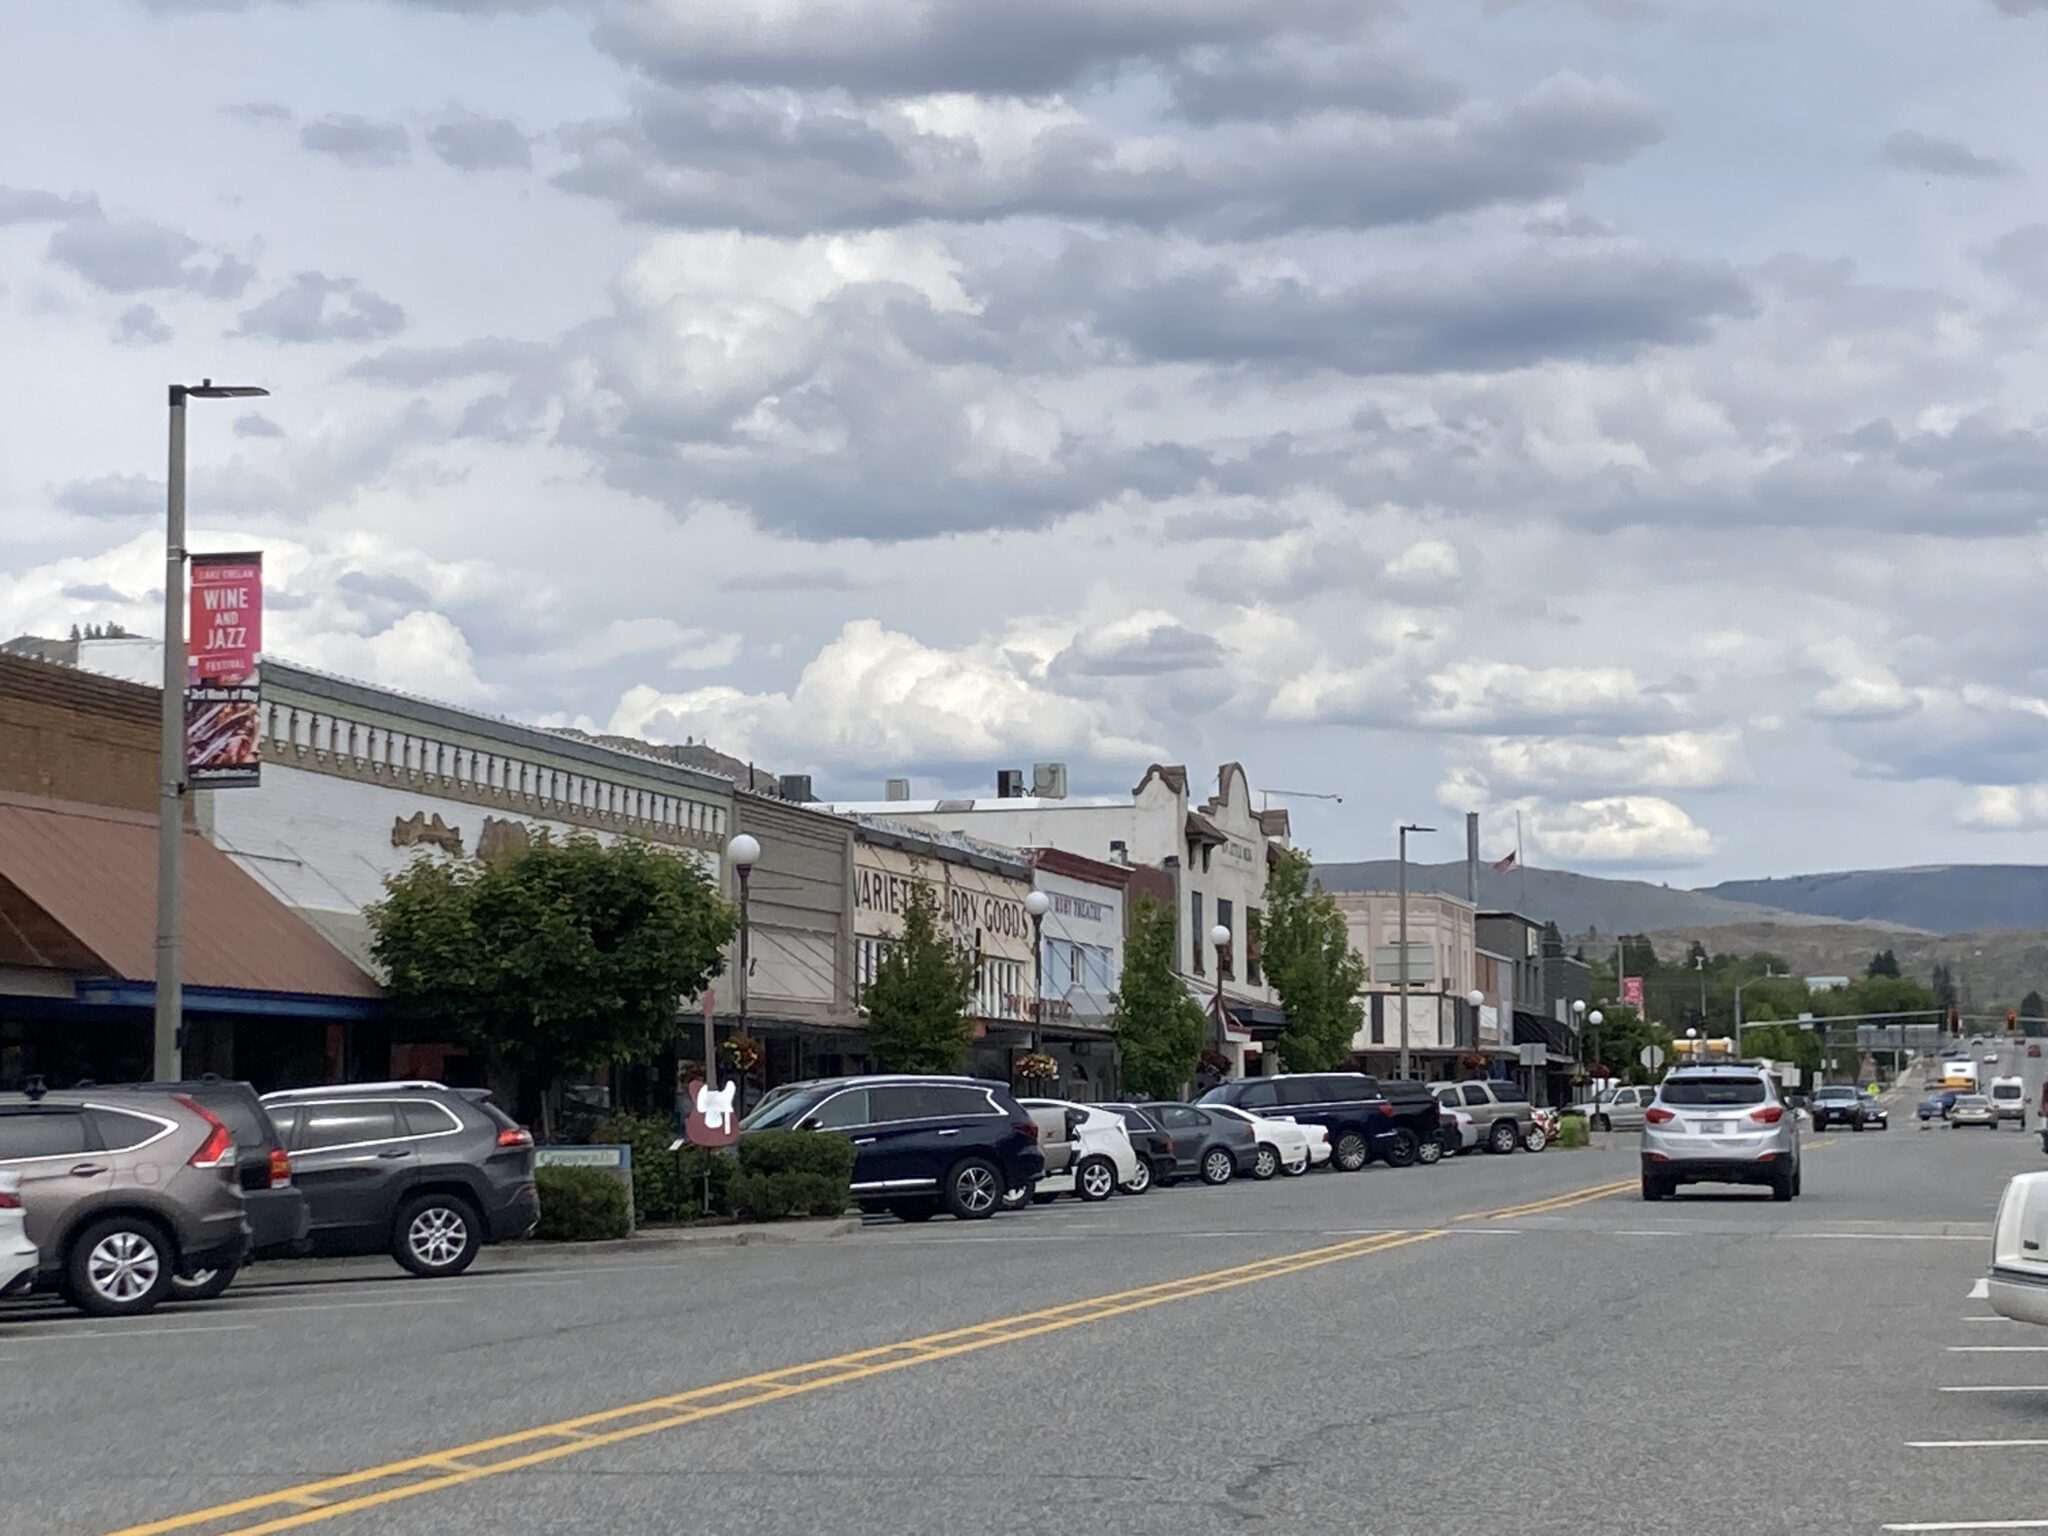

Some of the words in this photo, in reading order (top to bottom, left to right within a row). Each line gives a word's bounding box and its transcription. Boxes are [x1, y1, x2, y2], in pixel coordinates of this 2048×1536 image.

[204, 587, 248, 610] WINE
[215, 611, 239, 626] AND
[204, 627, 247, 650] JAZZ
[205, 659, 245, 672] FESTIVAL
[952, 889, 979, 927] DRY
[984, 898, 1028, 939] GOODS
